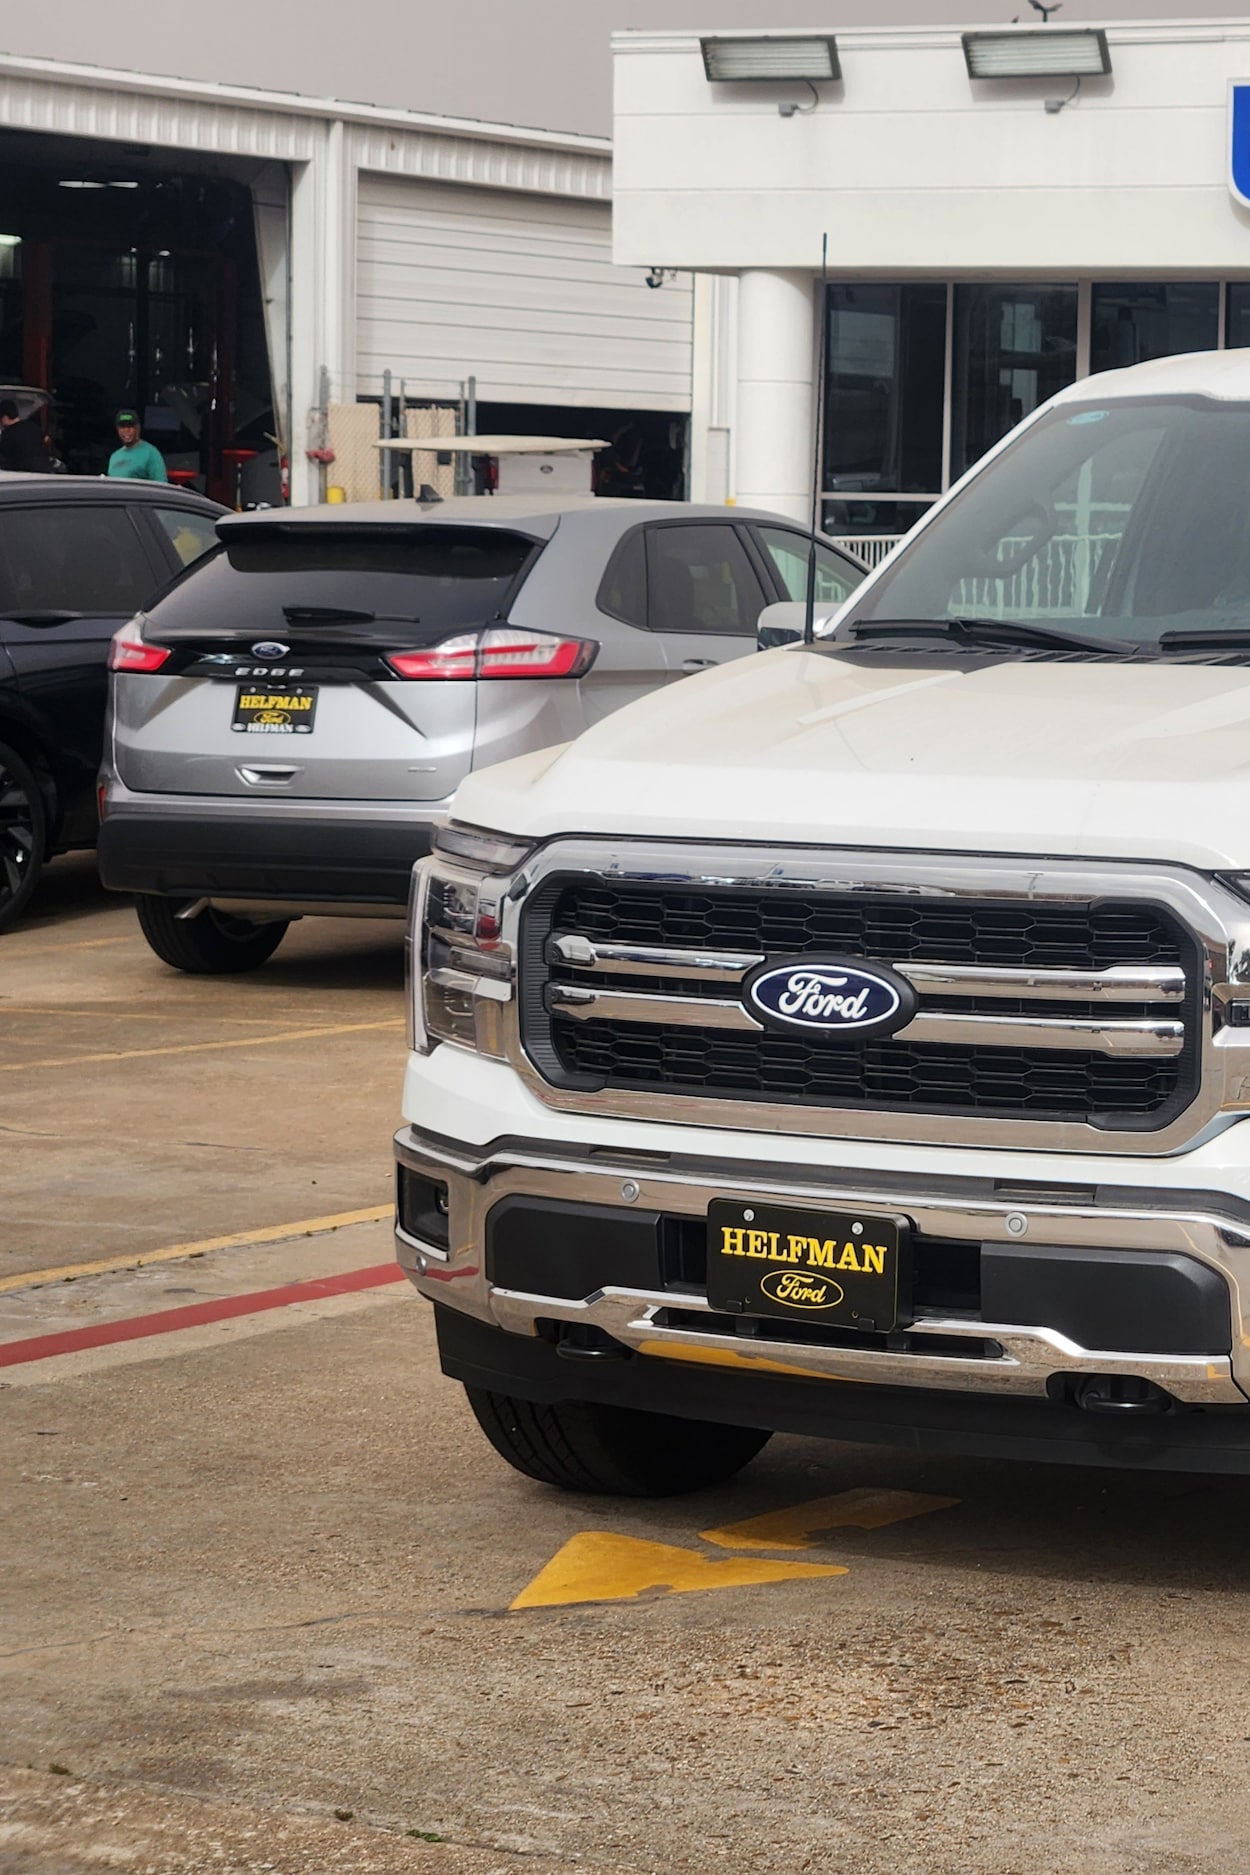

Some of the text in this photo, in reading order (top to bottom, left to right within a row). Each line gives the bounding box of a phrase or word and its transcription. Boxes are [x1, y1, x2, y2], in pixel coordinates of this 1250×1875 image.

[235, 667, 304, 676] EDGE
[239, 695, 313, 710] HELFMAN
[778, 972, 870, 1019] Ford
[720, 1227, 887, 1273] HELFMAN
[776, 1273, 827, 1303] Ford
